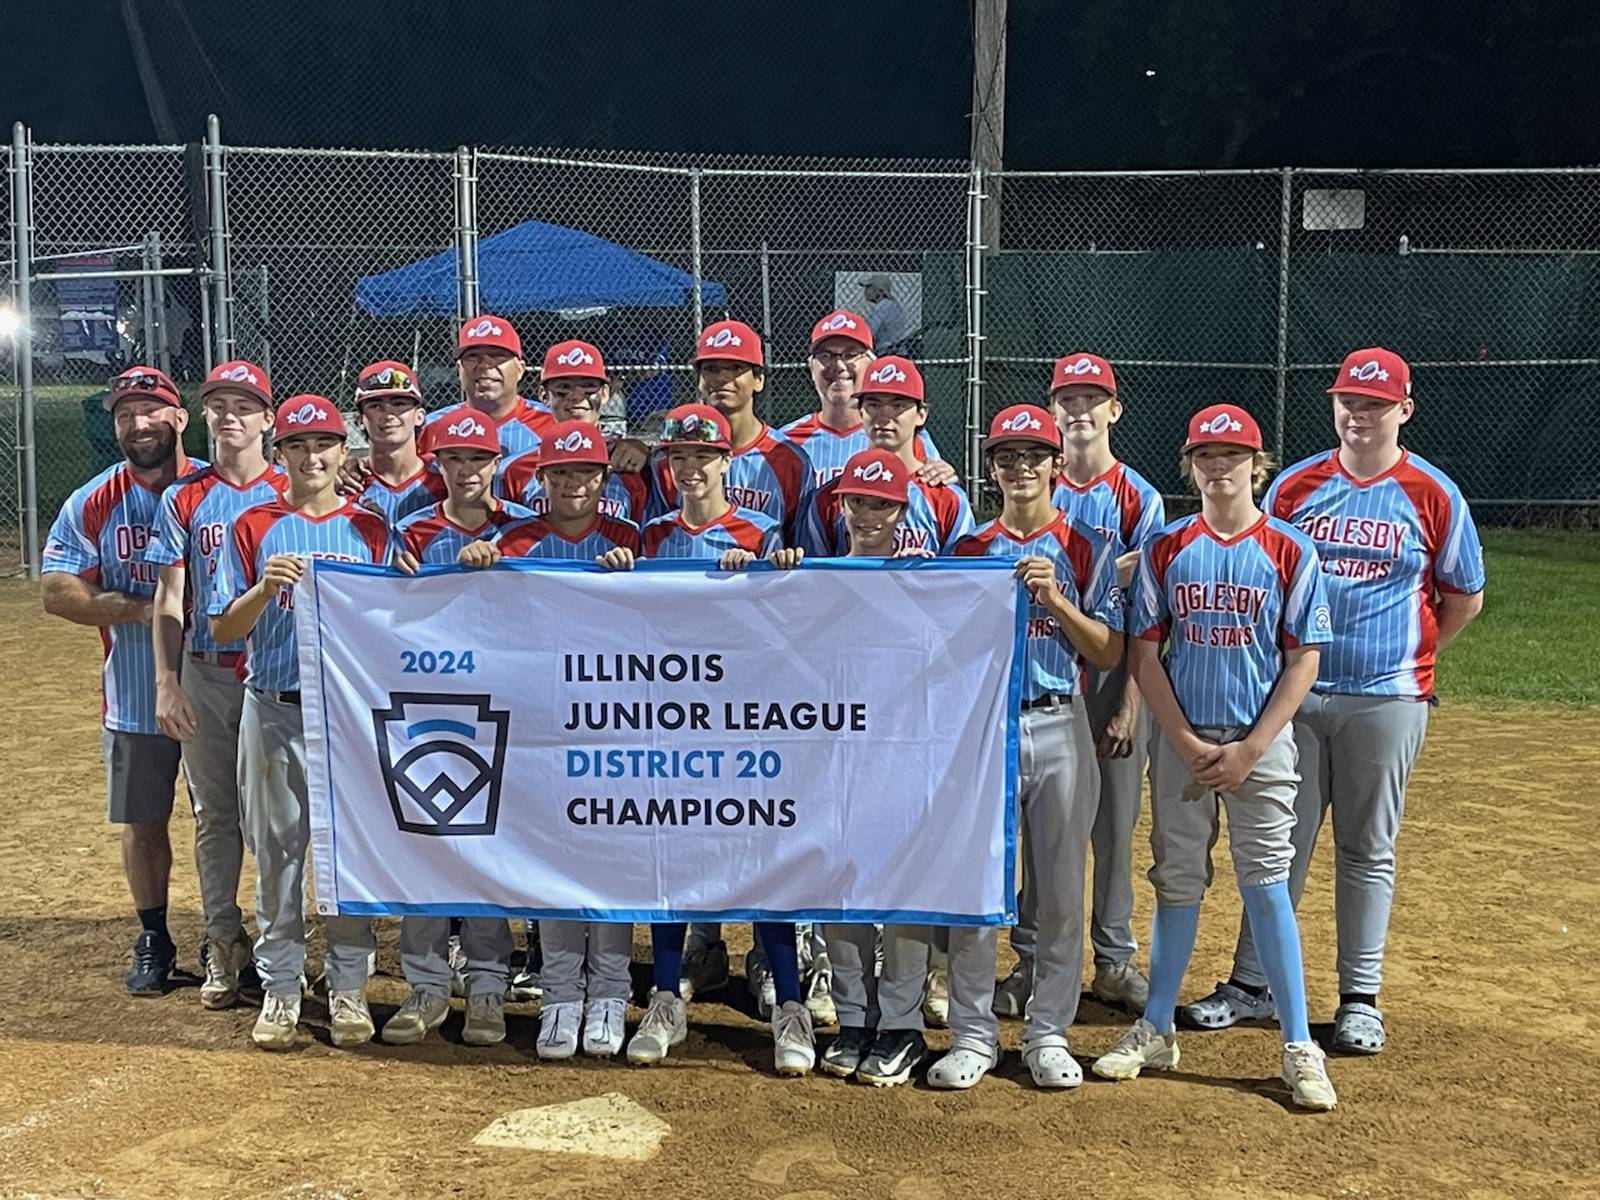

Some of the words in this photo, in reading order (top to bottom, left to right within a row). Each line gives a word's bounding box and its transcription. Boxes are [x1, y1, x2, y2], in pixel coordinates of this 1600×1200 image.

[1335, 558, 1391, 579] STARS
[1175, 582, 1269, 625] OGLESBY
[400, 650, 476, 674] 2024
[564, 653, 724, 683] ILLINOIS
[564, 701, 712, 731] JUNIOR
[724, 701, 867, 732] LEAGUE
[566, 749, 725, 779] DISTRICT
[735, 749, 782, 779] 20
[566, 797, 797, 828] CHAMPIONS
